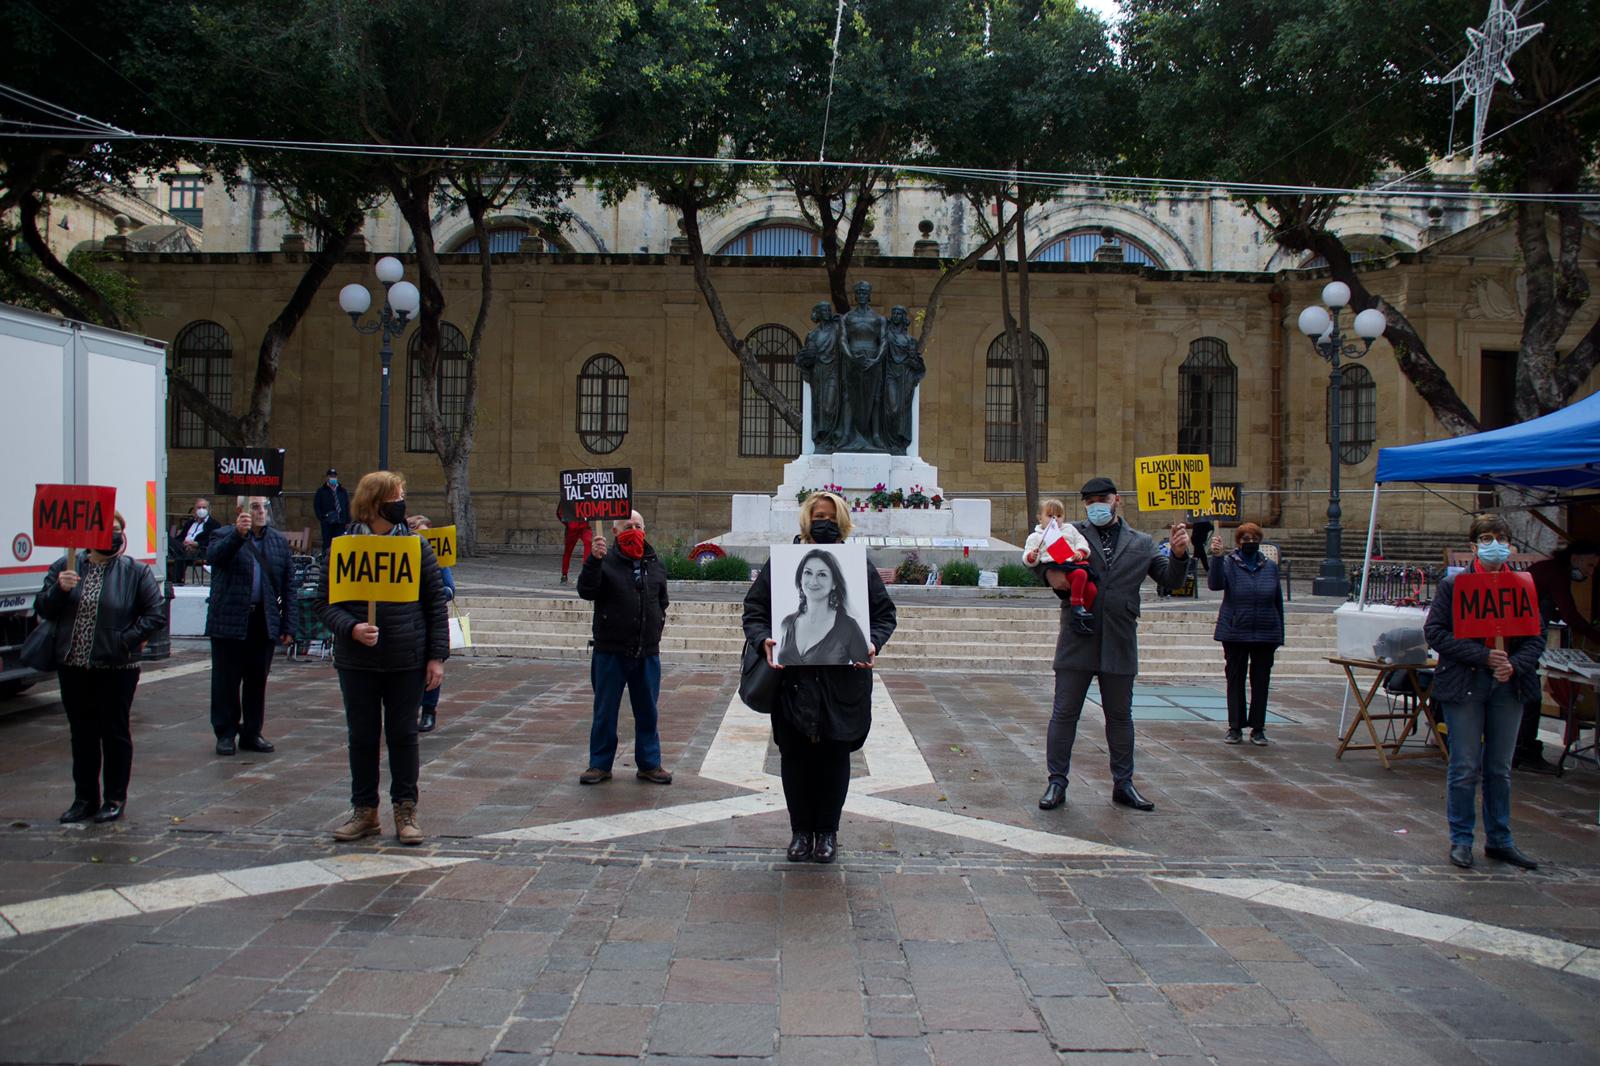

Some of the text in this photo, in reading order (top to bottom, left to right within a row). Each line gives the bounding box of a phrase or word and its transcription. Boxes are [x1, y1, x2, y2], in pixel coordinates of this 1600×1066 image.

[220, 457, 266, 475] SALTNA
[1140, 459, 1204, 474] FLIXKUN NBID
[563, 472, 614, 485] ID-DEPUTATI
[1158, 473, 1191, 490] BEJN
[564, 484, 628, 501] TAL-GVERN
[1210, 486, 1235, 502] AWK
[38, 498, 105, 532] MAFIA
[17, 541, 27, 554] 70
[428, 536, 452, 556] FIA
[336, 551, 413, 584] MAFIA
[1461, 588, 1534, 620] MAFIA
